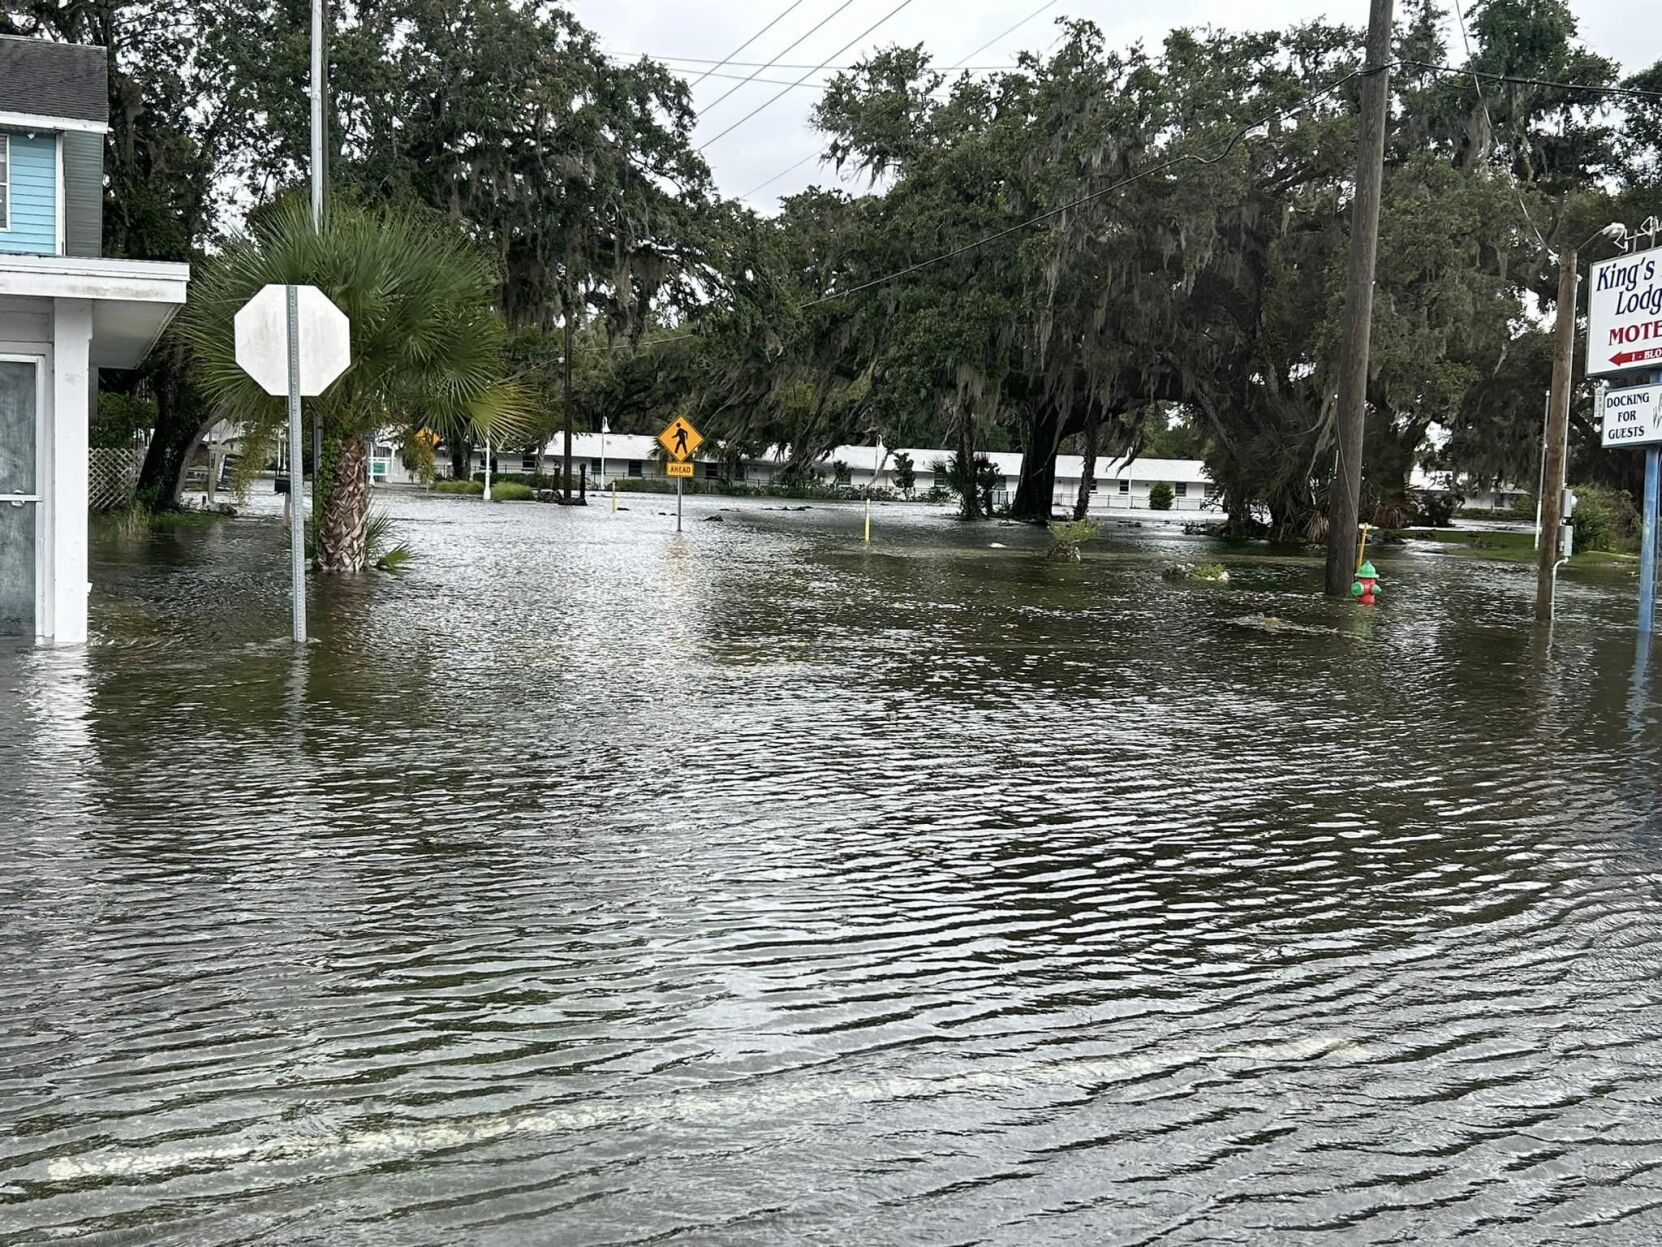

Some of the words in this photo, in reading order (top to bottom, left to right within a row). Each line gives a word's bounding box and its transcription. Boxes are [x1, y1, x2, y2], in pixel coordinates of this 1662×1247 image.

[1596, 257, 1655, 292] King's
[1607, 392, 1649, 408] DOCKING
[1617, 410, 1637, 422] FOR
[1608, 426, 1645, 439] GUESTS
[670, 465, 691, 474] AHEAD
